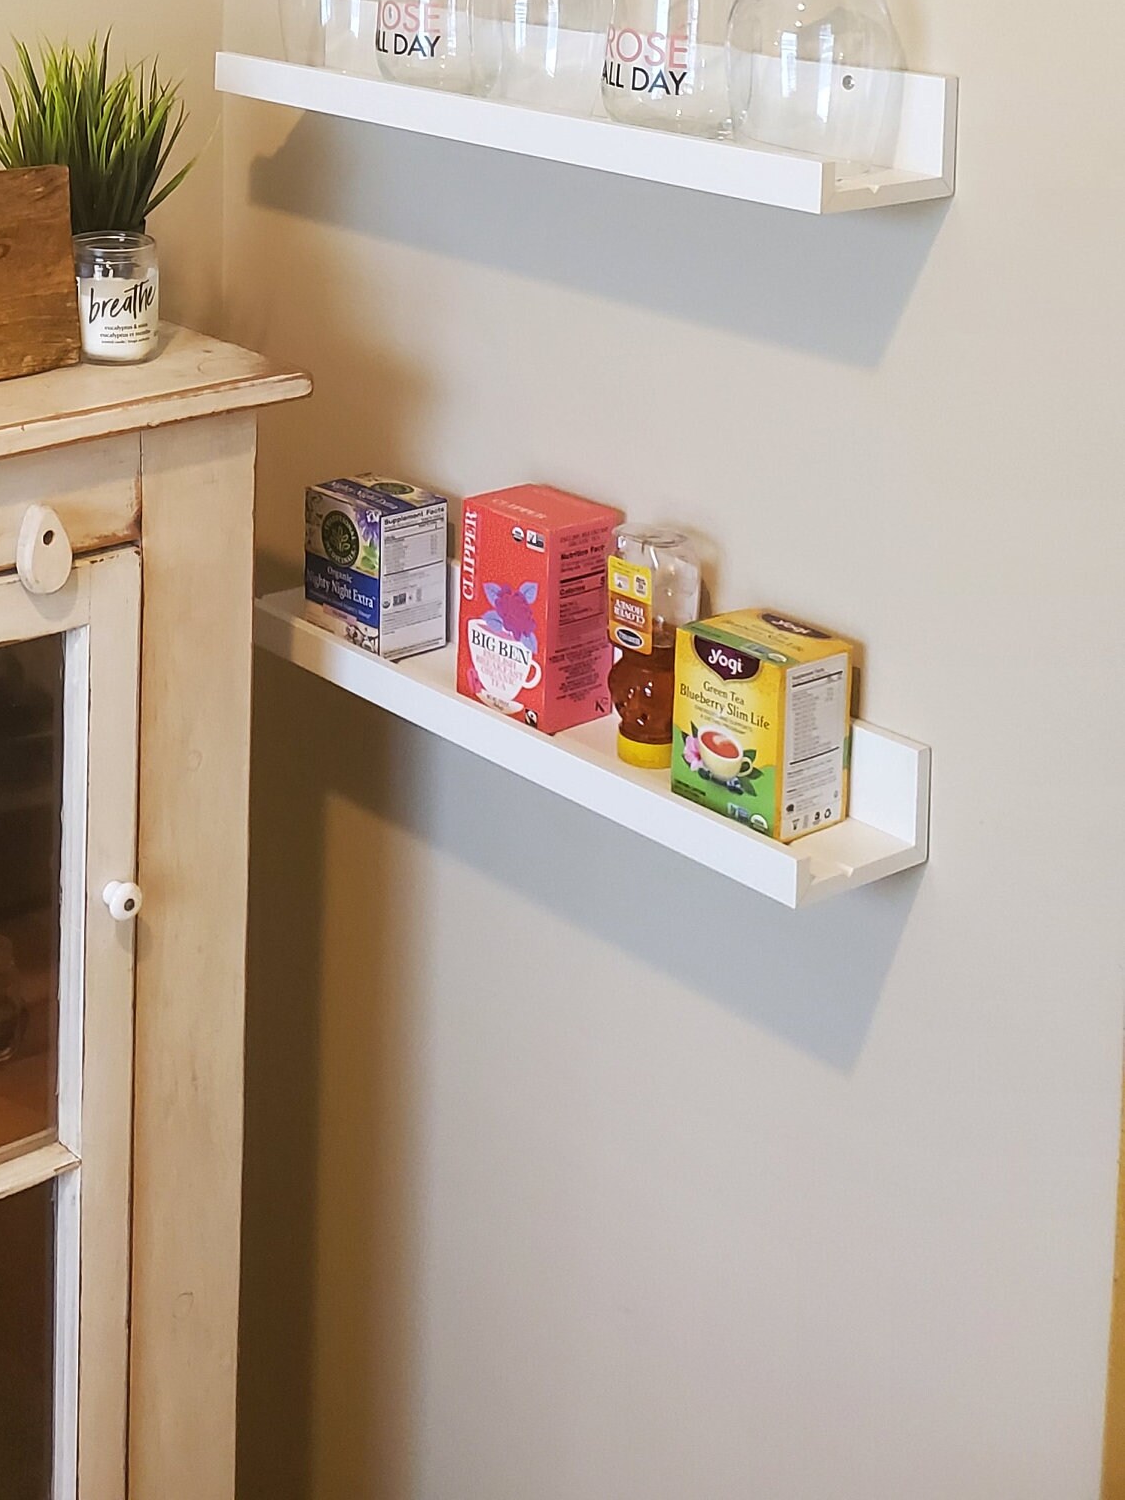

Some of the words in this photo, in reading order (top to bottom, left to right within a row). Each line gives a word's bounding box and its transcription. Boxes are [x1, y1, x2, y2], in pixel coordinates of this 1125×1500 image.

[394, 33, 441, 58] DAY
[602, 59, 624, 89] ALL
[632, 66, 687, 96] DAY
[88, 279, 156, 324] breathe
[384, 510, 424, 526] Supplement
[425, 506, 446, 517] Facts
[462, 508, 478, 601] CLIPPER
[327, 565, 353, 584] Organic
[331, 579, 352, 600] Night
[614, 606, 645, 625] CLOVER
[615, 599, 644, 617] HONEY
[471, 629, 496, 652] BIG
[499, 640, 530, 666] BEN
[703, 680, 728, 699] Green
[729, 691, 745, 706] Tea
[679, 683, 724, 714] Blueberry
[727, 702, 749, 722] Slim
[750, 711, 771, 730] Life
